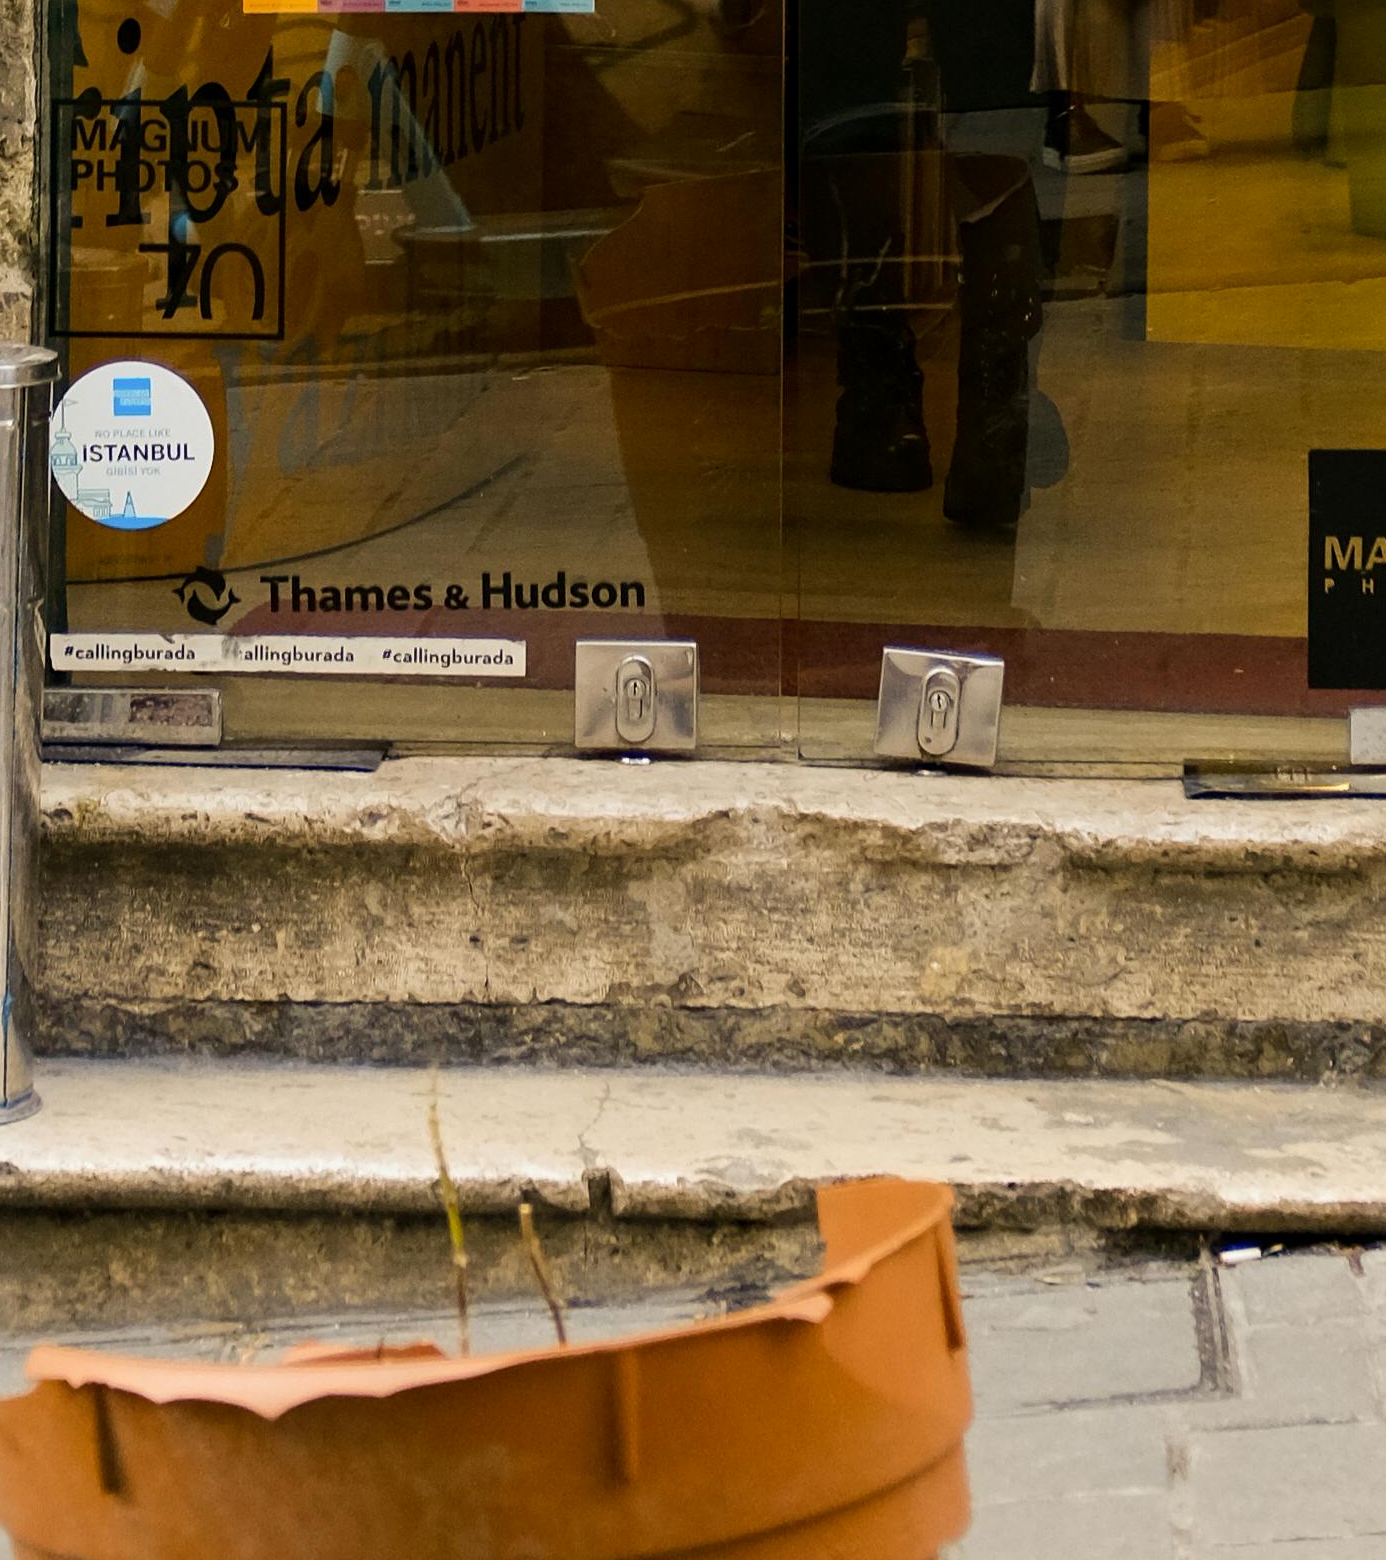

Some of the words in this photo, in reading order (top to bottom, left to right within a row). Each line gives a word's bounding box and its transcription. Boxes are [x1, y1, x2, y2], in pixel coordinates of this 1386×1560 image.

[94, 429, 111, 439] NO
[114, 429, 144, 439] PLACE
[148, 427, 172, 438] LIKE
[260, 574, 433, 613] Thames
[445, 582, 470, 610] &
[480, 571, 646, 610] Hudson
[63, 643, 197, 664] #callingburada
[382, 647, 515, 669] #callingburada
